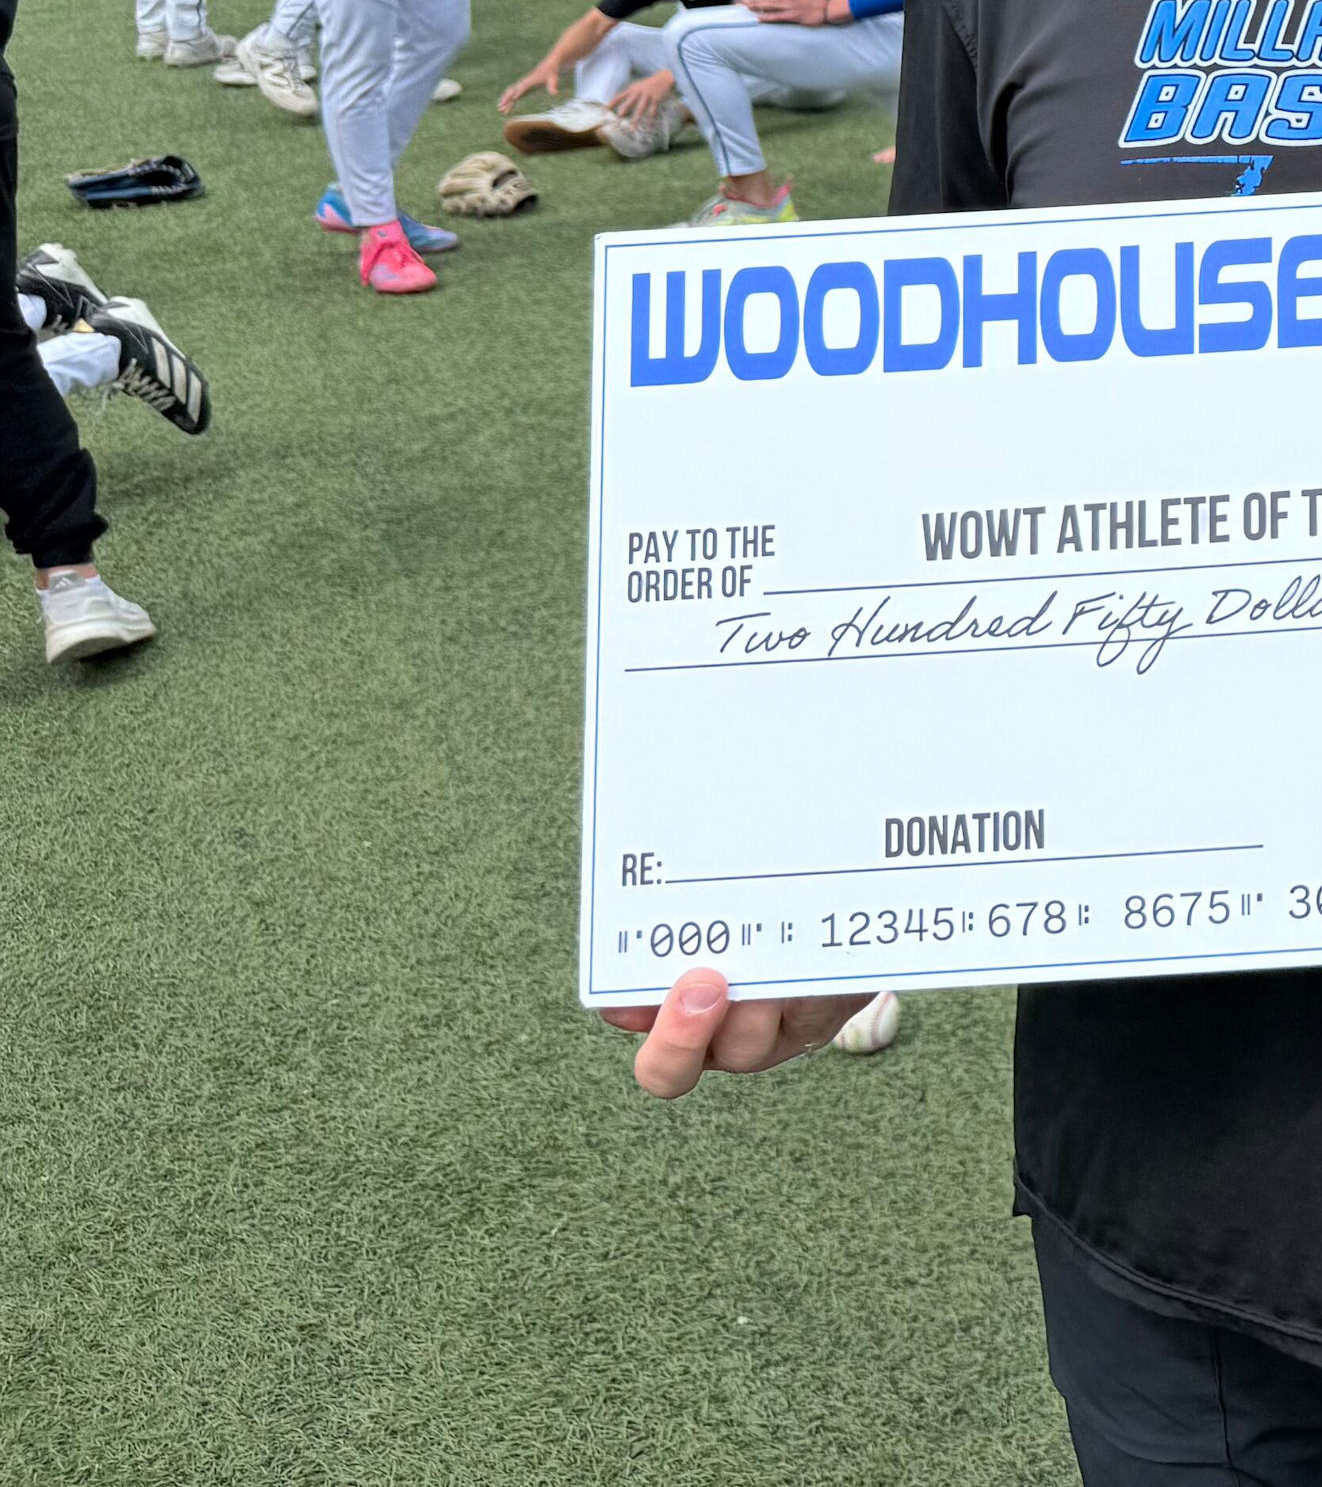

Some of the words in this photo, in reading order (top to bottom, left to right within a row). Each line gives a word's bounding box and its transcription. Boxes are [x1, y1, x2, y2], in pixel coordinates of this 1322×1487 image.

[628, 530, 680, 564] PAY
[687, 528, 718, 561] TO
[726, 524, 775, 559] THE
[922, 505, 1047, 562] WOWT
[1057, 495, 1230, 553] ATHLETE
[1243, 490, 1292, 543] OF
[627, 569, 714, 603] ORDER
[722, 566, 752, 598] OF
[716, 612, 809, 656] Two
[828, 590, 1057, 657] Hundred
[1062, 591, 1193, 674] Fifty
[621, 853, 664, 888] RE:
[885, 808, 1046, 860] DONATION
